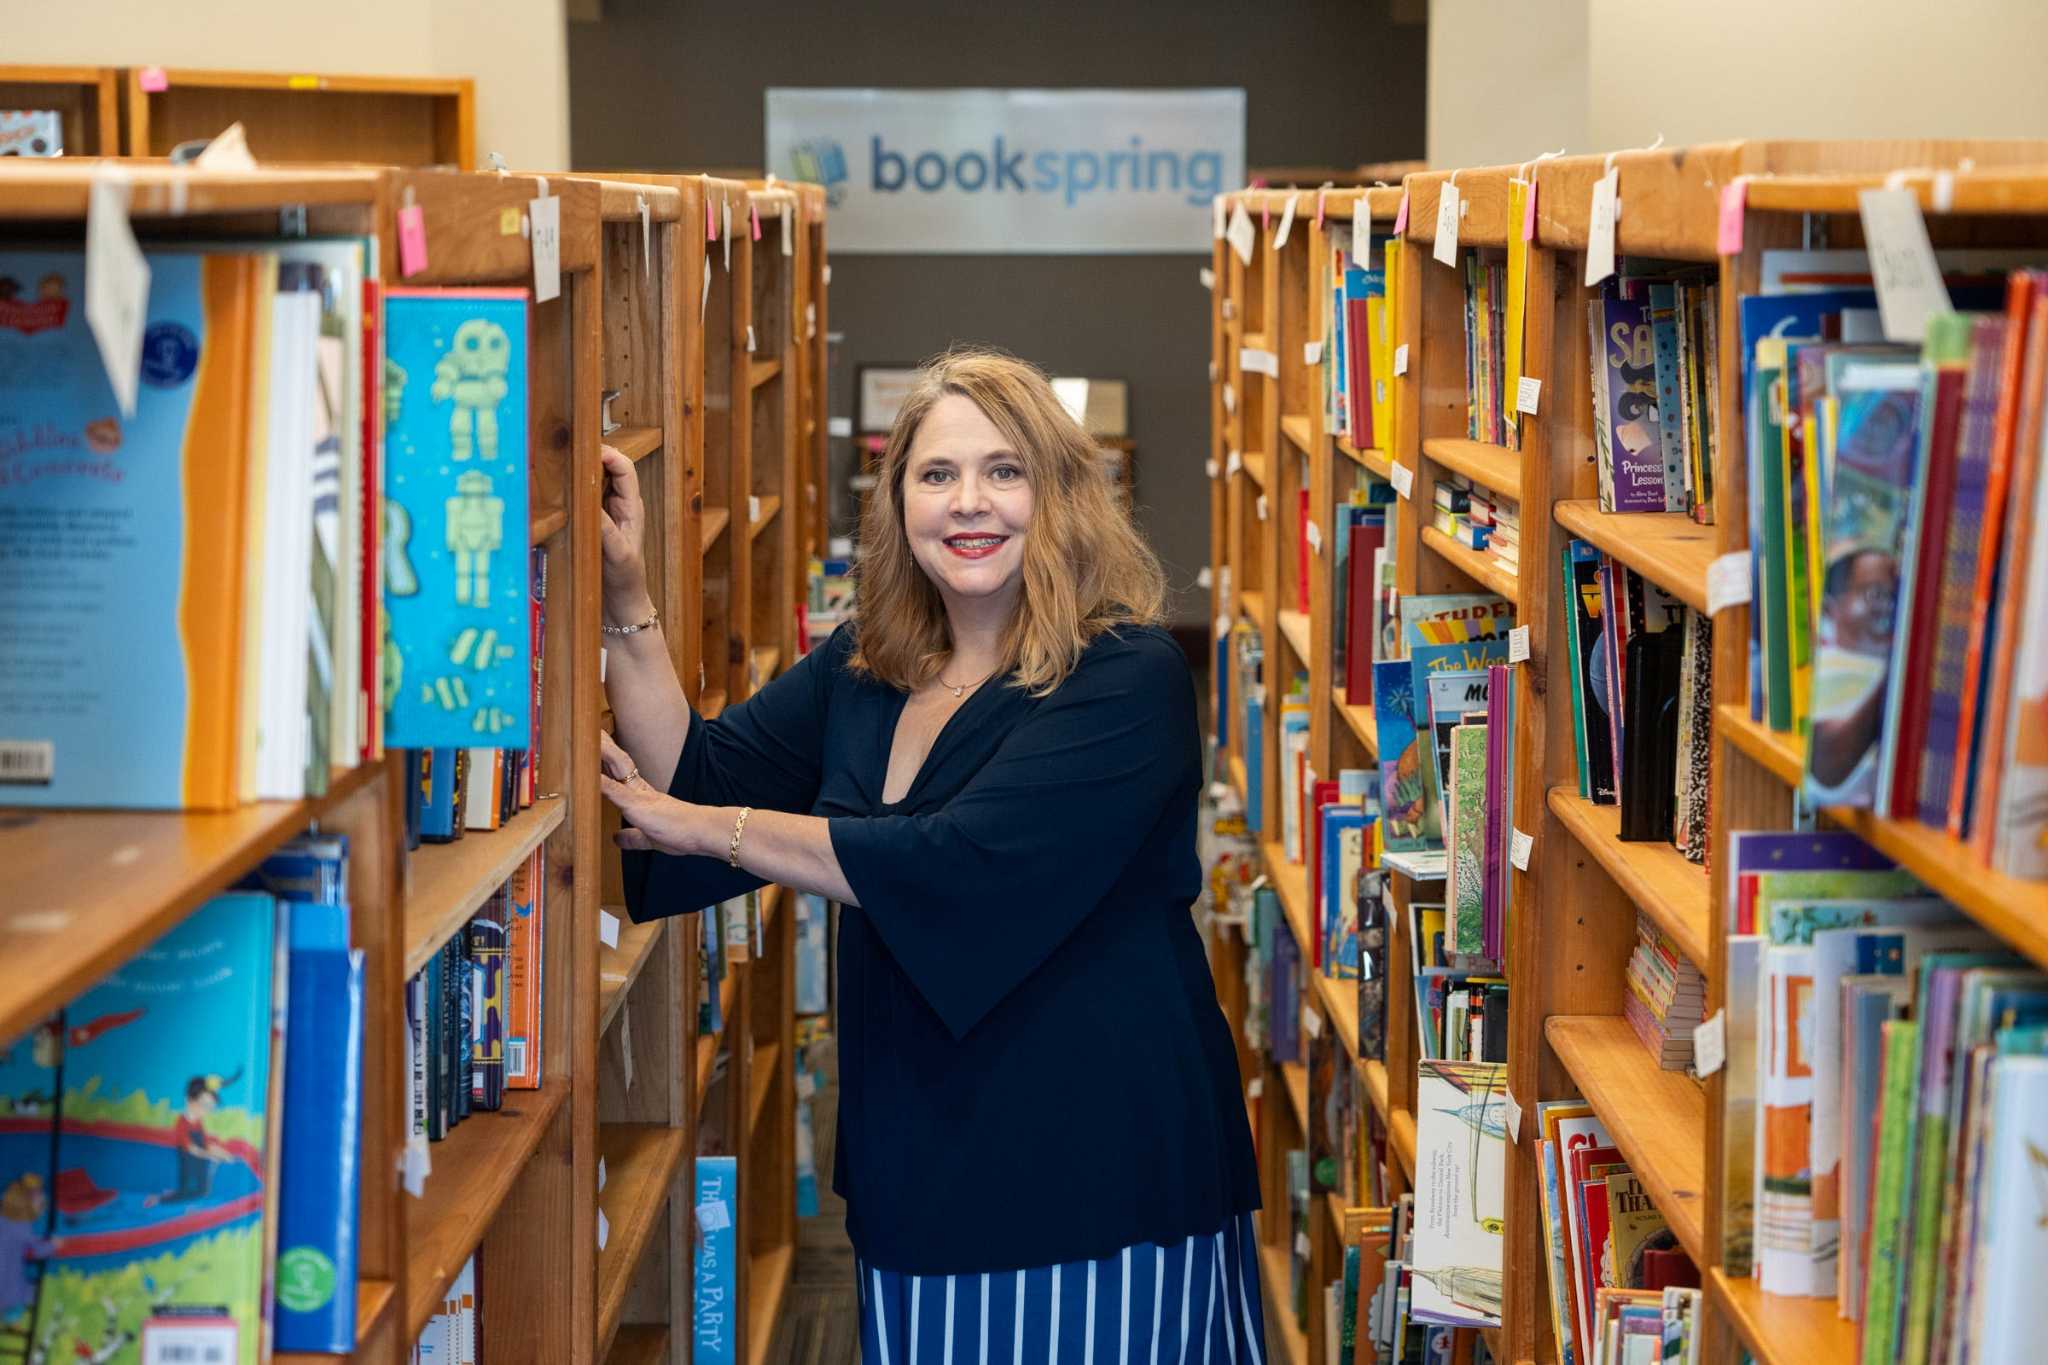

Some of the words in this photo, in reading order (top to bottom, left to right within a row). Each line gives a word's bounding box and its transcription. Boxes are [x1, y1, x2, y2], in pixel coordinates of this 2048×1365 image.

[871, 135, 1224, 206] bookspring
[702, 1234, 717, 1268] WAS
[702, 1272, 716, 1284] A
[699, 1285, 724, 1352] PARTY
